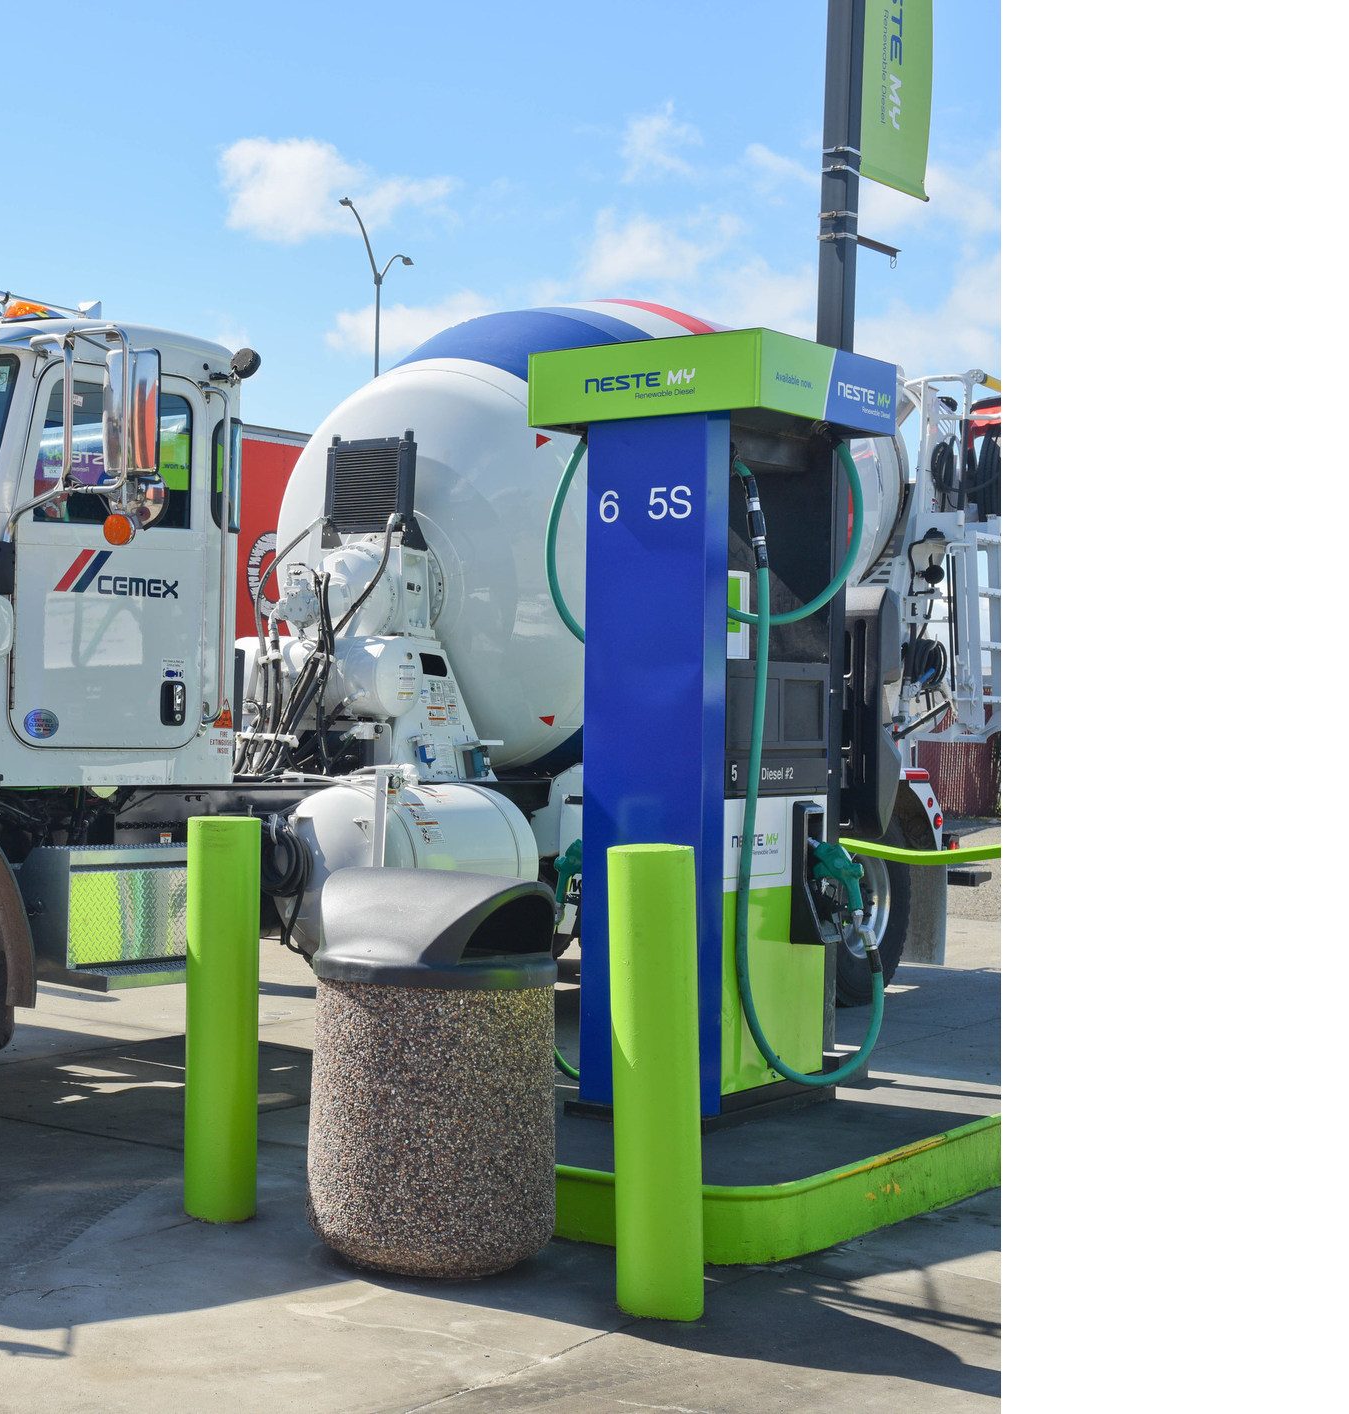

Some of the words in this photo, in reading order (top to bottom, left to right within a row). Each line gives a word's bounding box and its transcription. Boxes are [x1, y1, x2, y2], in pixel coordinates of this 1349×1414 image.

[881, 9, 889, 81] Renewable
[890, 0, 903, 65] TE
[889, 73, 902, 131] MY
[584, 371, 661, 394] NESTE
[666, 367, 696, 386] MY
[634, 389, 673, 400] Renewable
[674, 386, 696, 396] Diesel
[775, 371, 800, 387] Available
[800, 379, 814, 389] now.
[837, 381, 876, 406] NESTE
[877, 392, 891, 409] MY
[599, 489, 620, 523] 6
[647, 484, 693, 520] 5S
[97, 575, 179, 599] CEMEX
[731, 764, 738, 782] 5
[761, 767, 784, 780] Diesel
[784, 767, 794, 780] #2
[765, 833, 779, 846] MY
